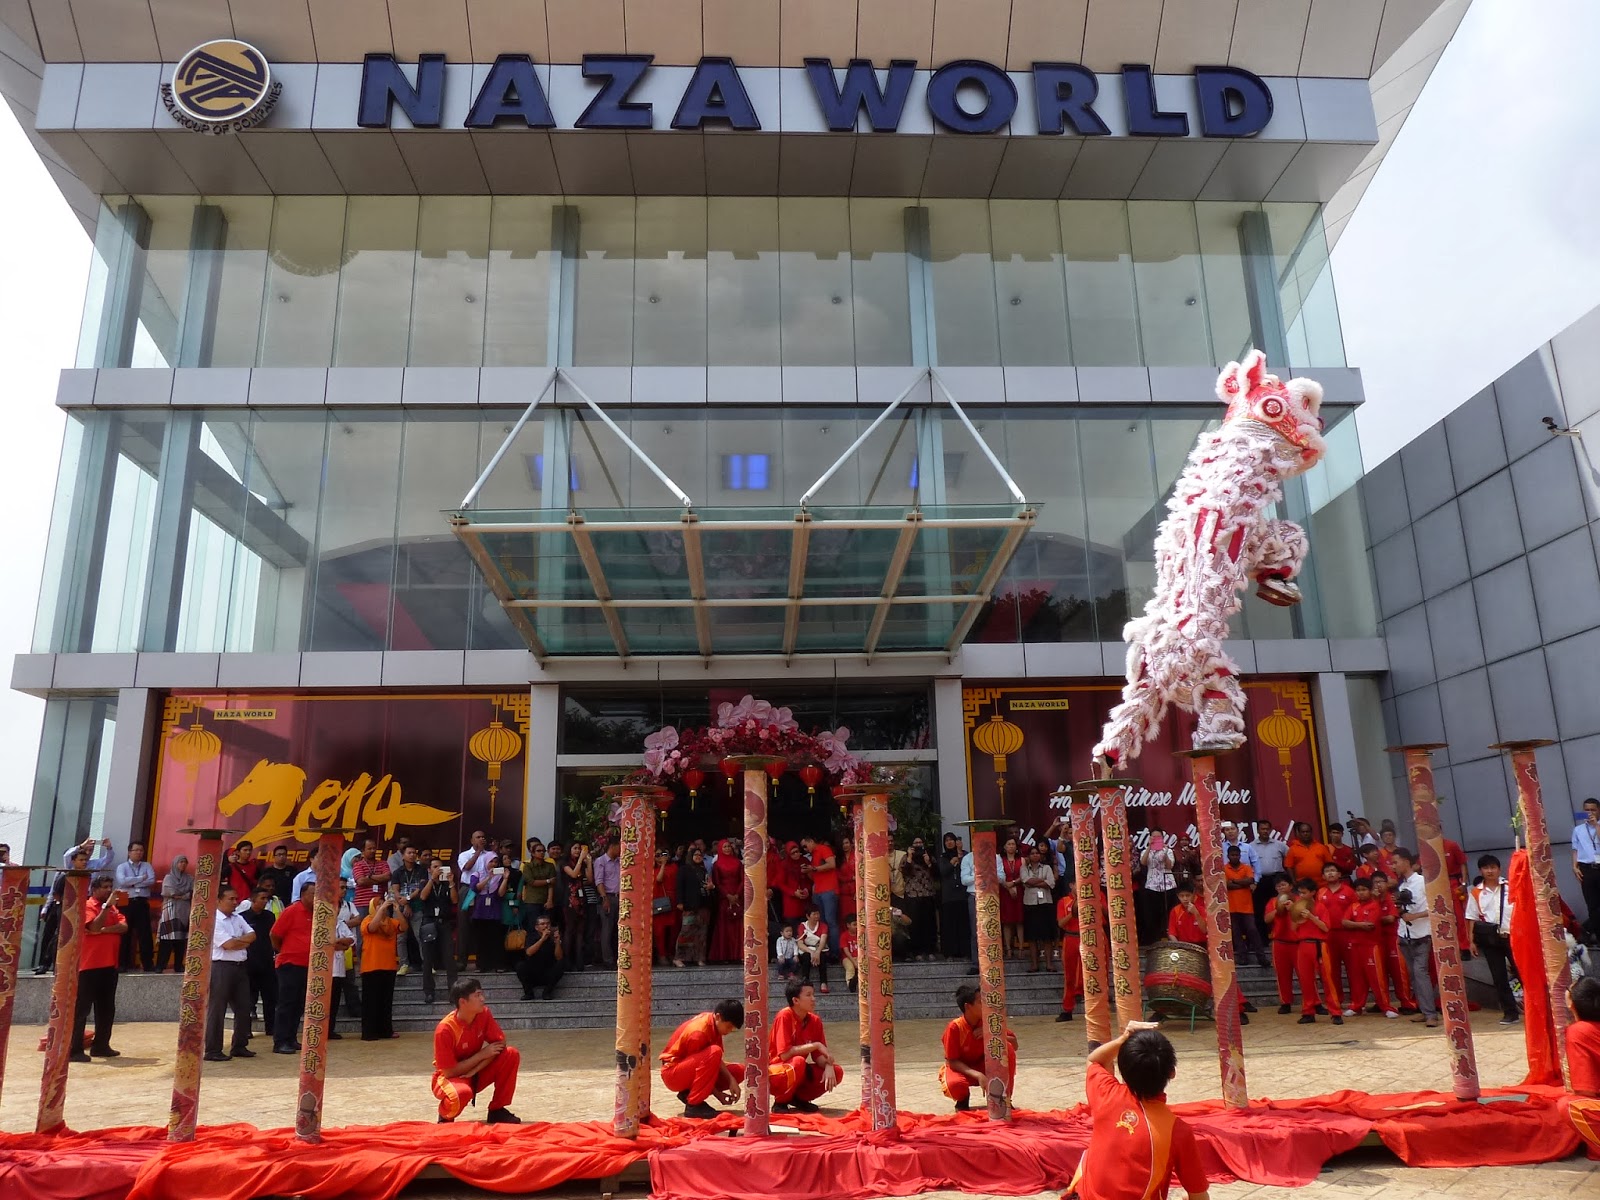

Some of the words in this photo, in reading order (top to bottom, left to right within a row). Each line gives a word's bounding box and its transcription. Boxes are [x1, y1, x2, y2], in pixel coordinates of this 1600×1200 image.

[160, 83, 177, 112] NAZA
[171, 110, 210, 133] GROUP
[213, 124, 229, 135] OF
[233, 81, 283, 132] COMPANIES
[357, 53, 762, 131] NAZA
[803, 57, 1274, 138] WORLD
[1038, 700, 1066, 708] WORLD
[218, 758, 462, 848] 2014
[1049, 784, 1101, 819] Hay
[1119, 782, 1172, 807] hinese
[1215, 780, 1252, 804] Year
